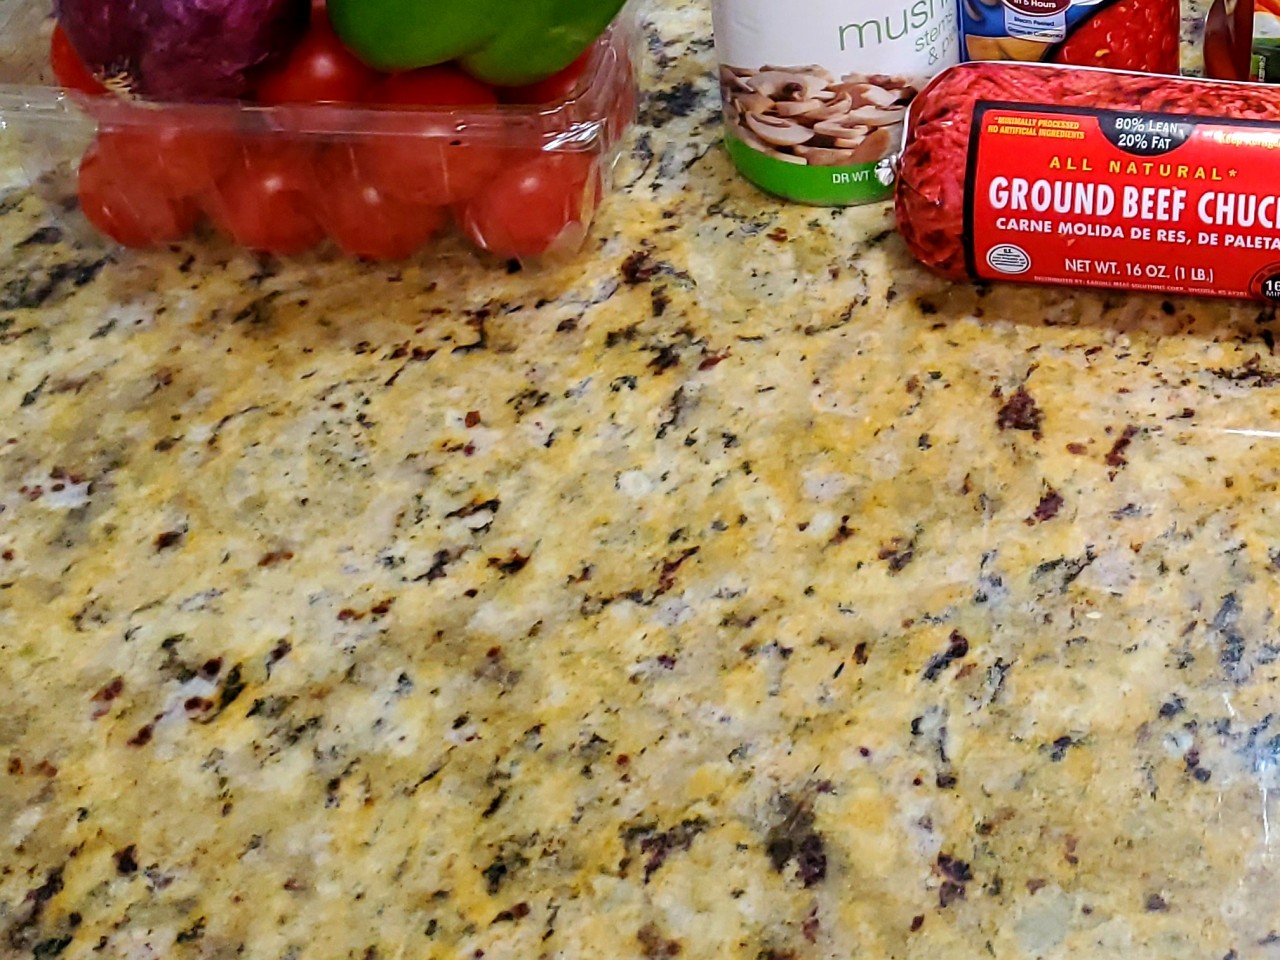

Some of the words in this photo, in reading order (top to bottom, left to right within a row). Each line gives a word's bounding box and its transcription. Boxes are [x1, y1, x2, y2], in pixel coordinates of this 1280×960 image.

[1031, 0, 1057, 9] Hours
[1000, 125, 1037, 136] ARTIFICIAL
[1038, 128, 1085, 140] INGREDIENTS
[1115, 117, 1145, 133] 80%
[1149, 119, 1179, 134] LEAN
[1117, 133, 1148, 150] 20%
[1151, 135, 1172, 150] FAT
[1049, 156, 1093, 171] ALL
[832, 171, 850, 185] DR
[851, 169, 871, 183] WT
[988, 176, 1116, 217] GROUND
[1122, 185, 1187, 222] BEEF
[995, 217, 1052, 234] CARNE
[1057, 221, 1125, 239] MOLIDA
[1130, 227, 1151, 241] DE
[1156, 228, 1192, 246] RES,
[1197, 232, 1219, 246] DE
[1064, 258, 1092, 273] NET
[1094, 260, 1121, 276] WT.
[1126, 262, 1142, 277] 16
[1145, 264, 1171, 279] OZ.
[1174, 265, 1186, 281] (1
[1191, 267, 1214, 284] LB.)
